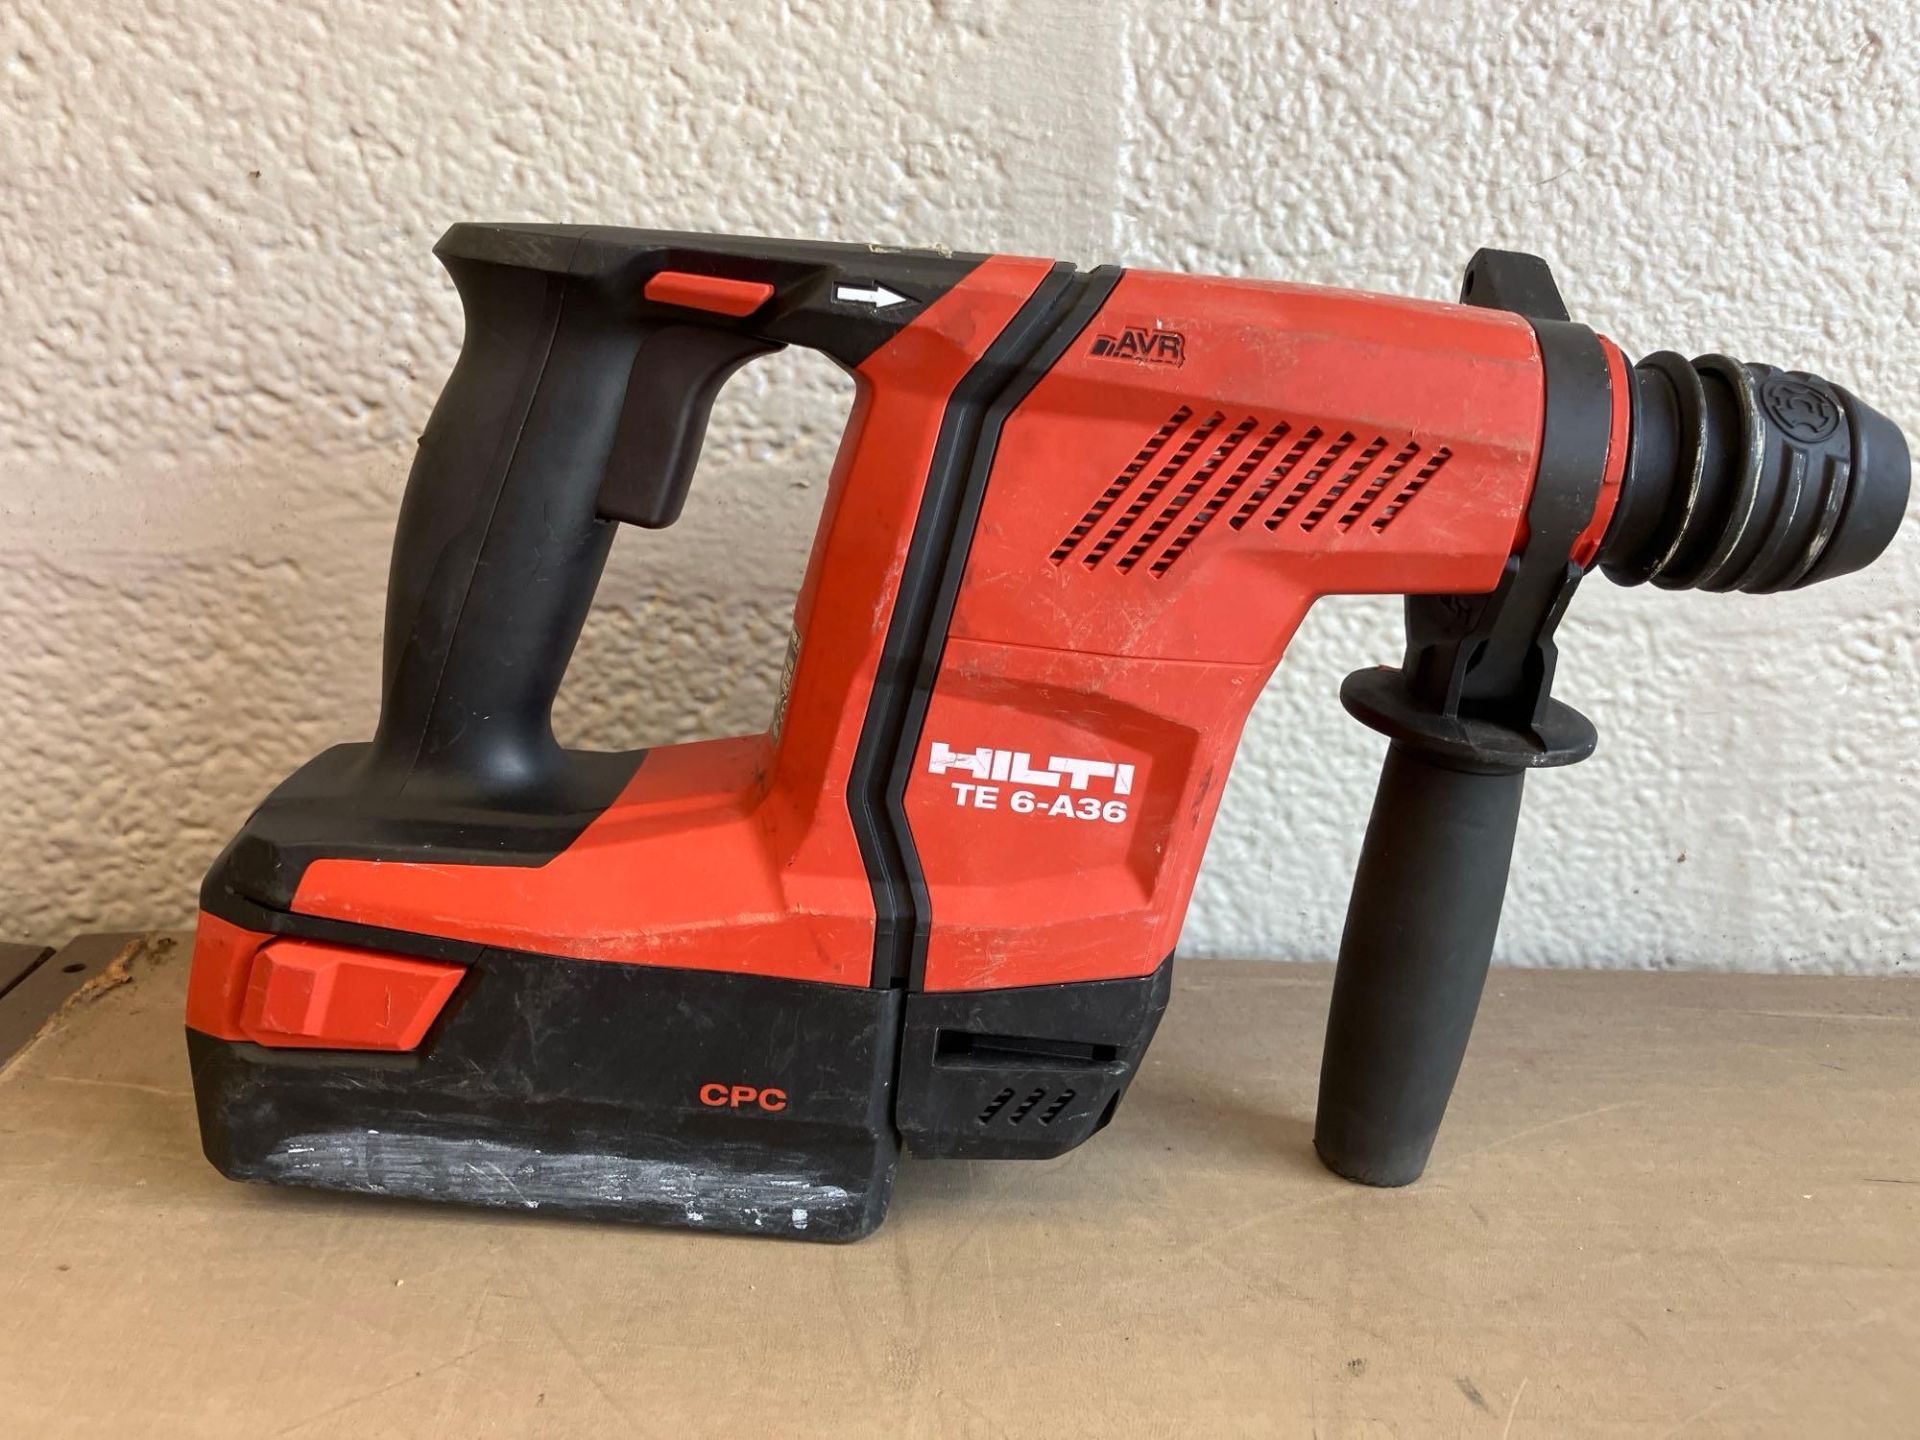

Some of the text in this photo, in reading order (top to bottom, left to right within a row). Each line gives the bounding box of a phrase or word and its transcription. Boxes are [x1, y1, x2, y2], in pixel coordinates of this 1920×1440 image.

[1116, 330, 1181, 359] AVR
[928, 742, 1135, 795] HILTI
[951, 783, 1128, 823] TE 6-A36
[700, 1083, 787, 1111] CPC
